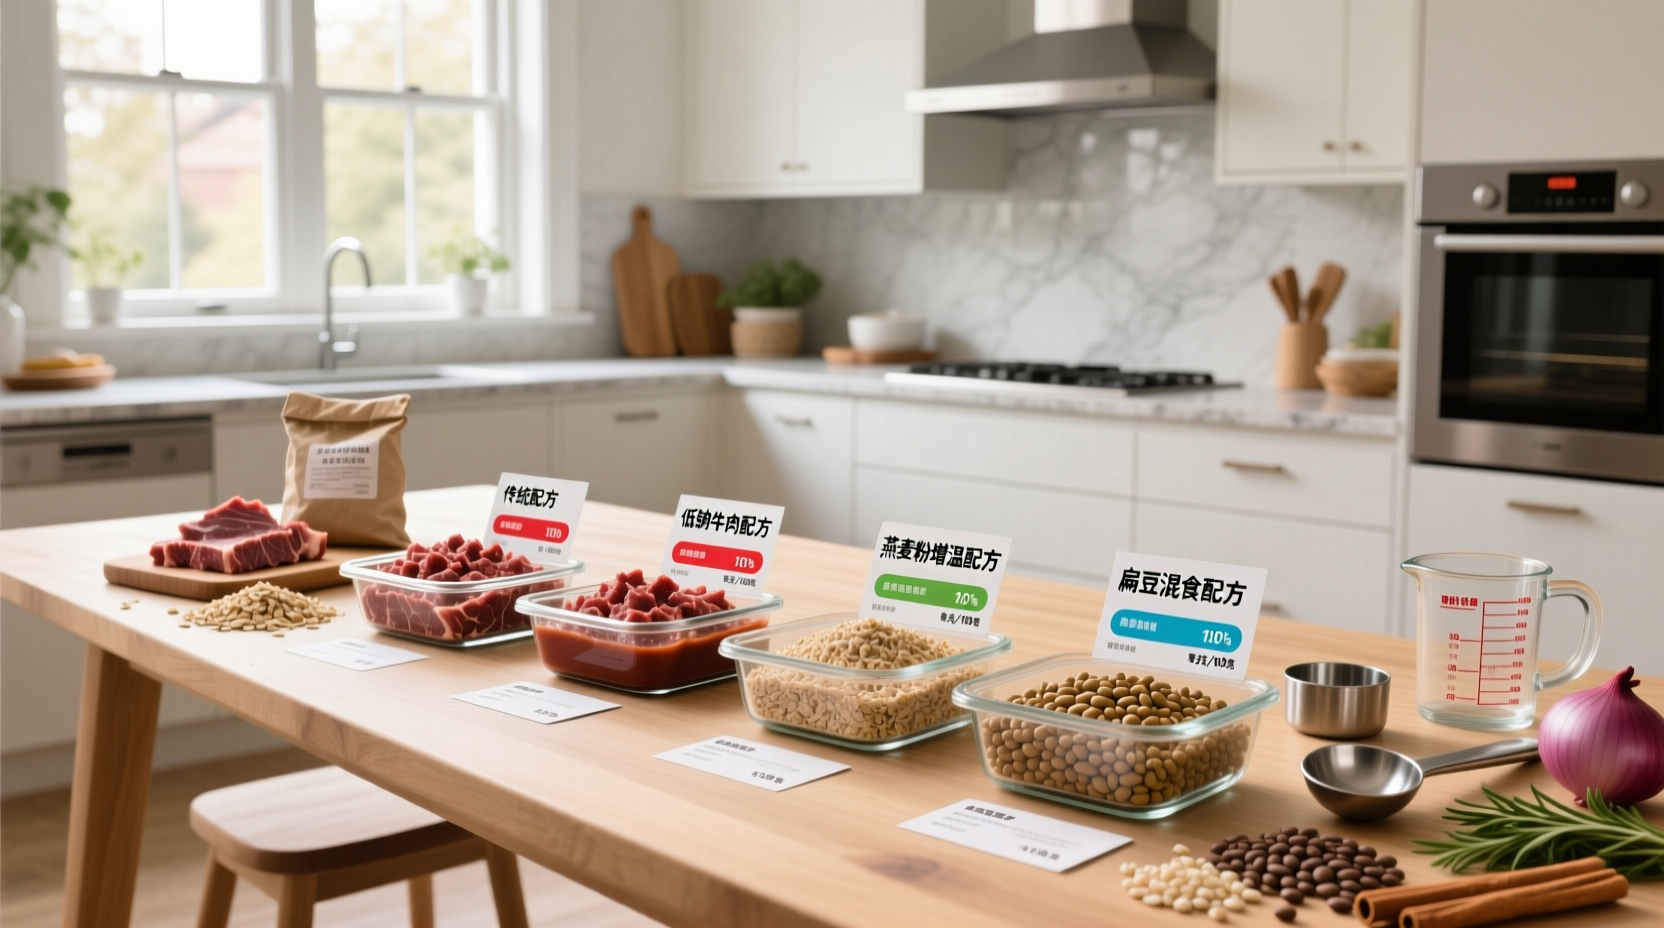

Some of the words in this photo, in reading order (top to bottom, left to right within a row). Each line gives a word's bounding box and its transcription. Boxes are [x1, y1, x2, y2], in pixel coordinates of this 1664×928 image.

[503, 485, 559, 509] 传统配方
[1117, 566, 1247, 607] 扁豆混食配方
